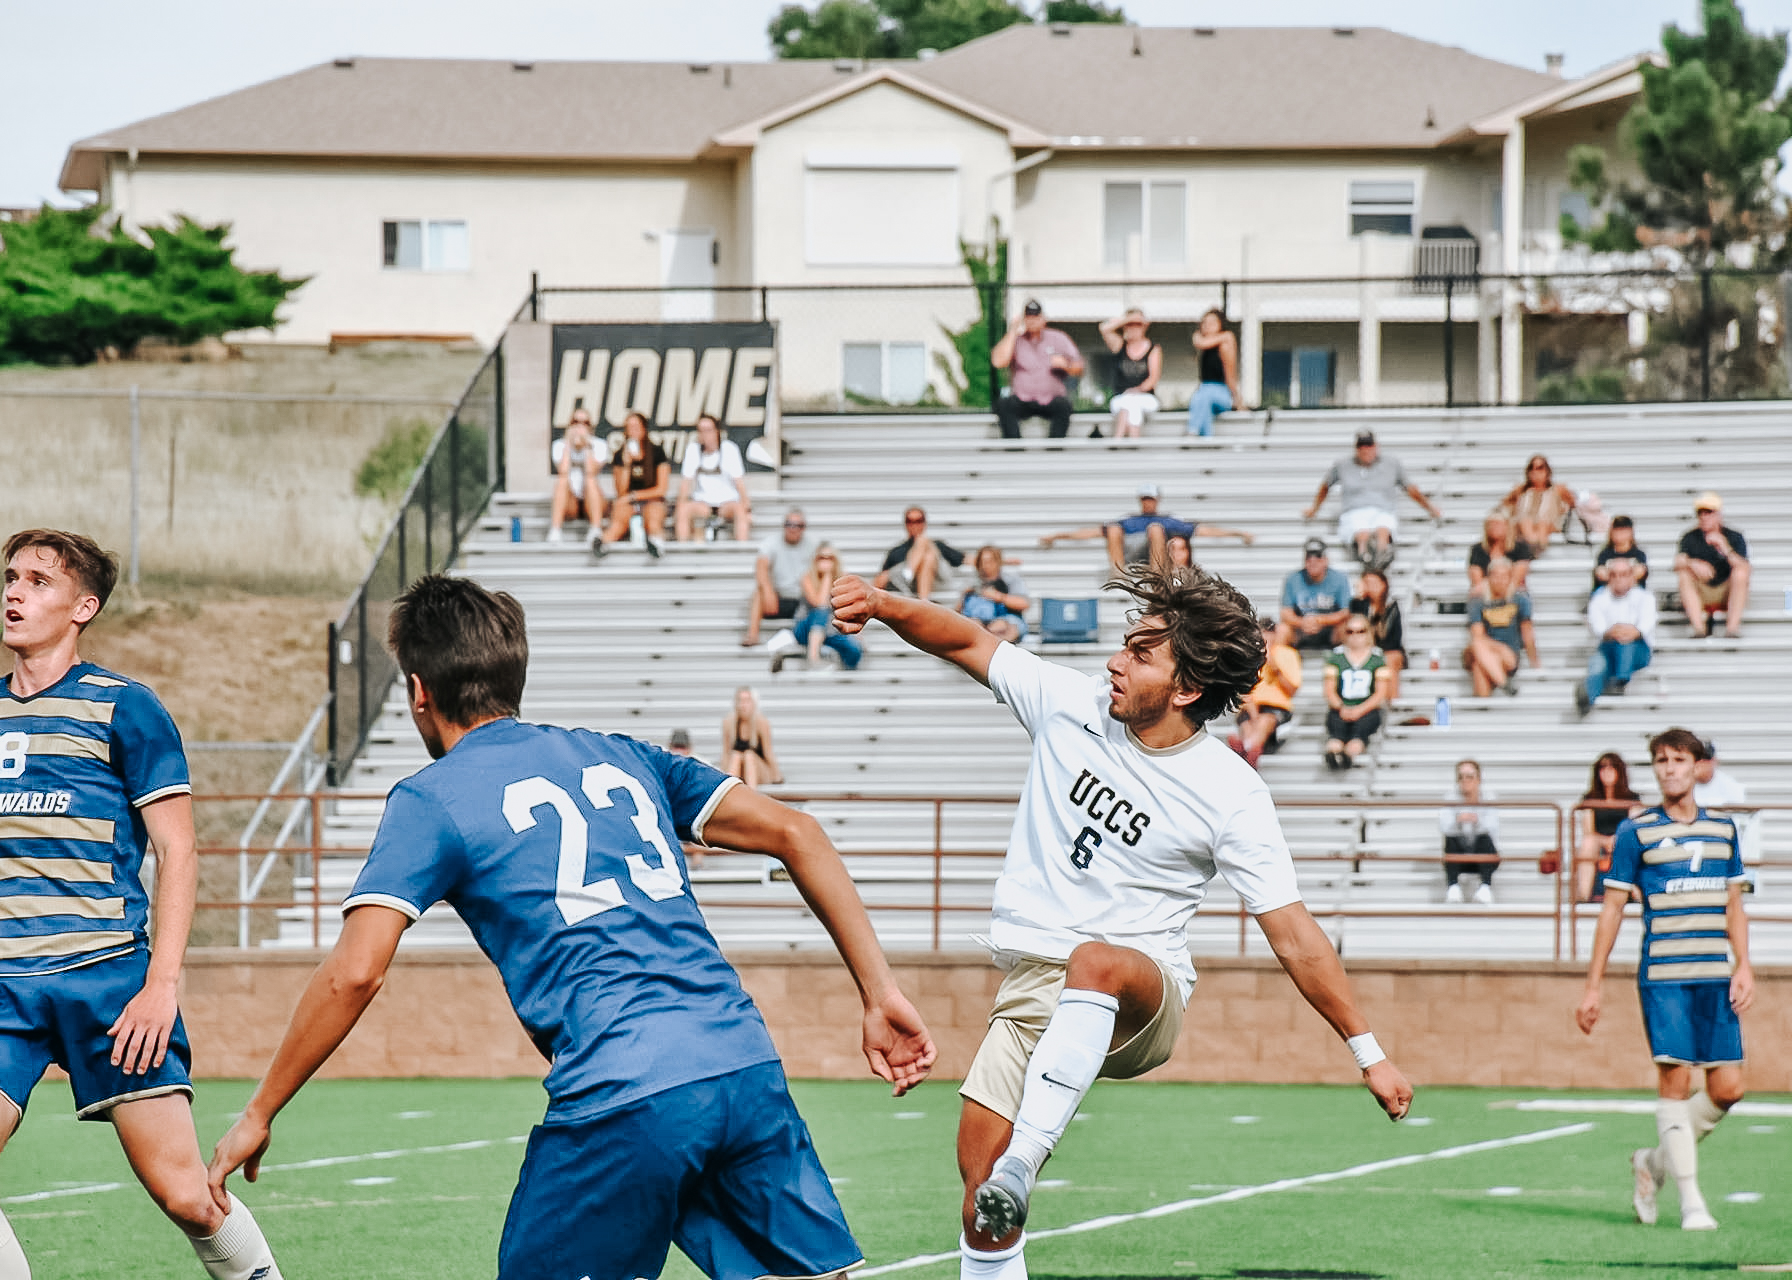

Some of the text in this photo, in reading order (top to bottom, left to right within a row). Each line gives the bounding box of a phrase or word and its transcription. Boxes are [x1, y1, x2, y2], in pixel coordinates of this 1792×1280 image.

[553, 347, 773, 427] HOME
[502, 762, 685, 927] 23
[1069, 768, 1151, 847] UCCS
[1069, 825, 1103, 870] 6
[1682, 840, 1704, 873] 7
